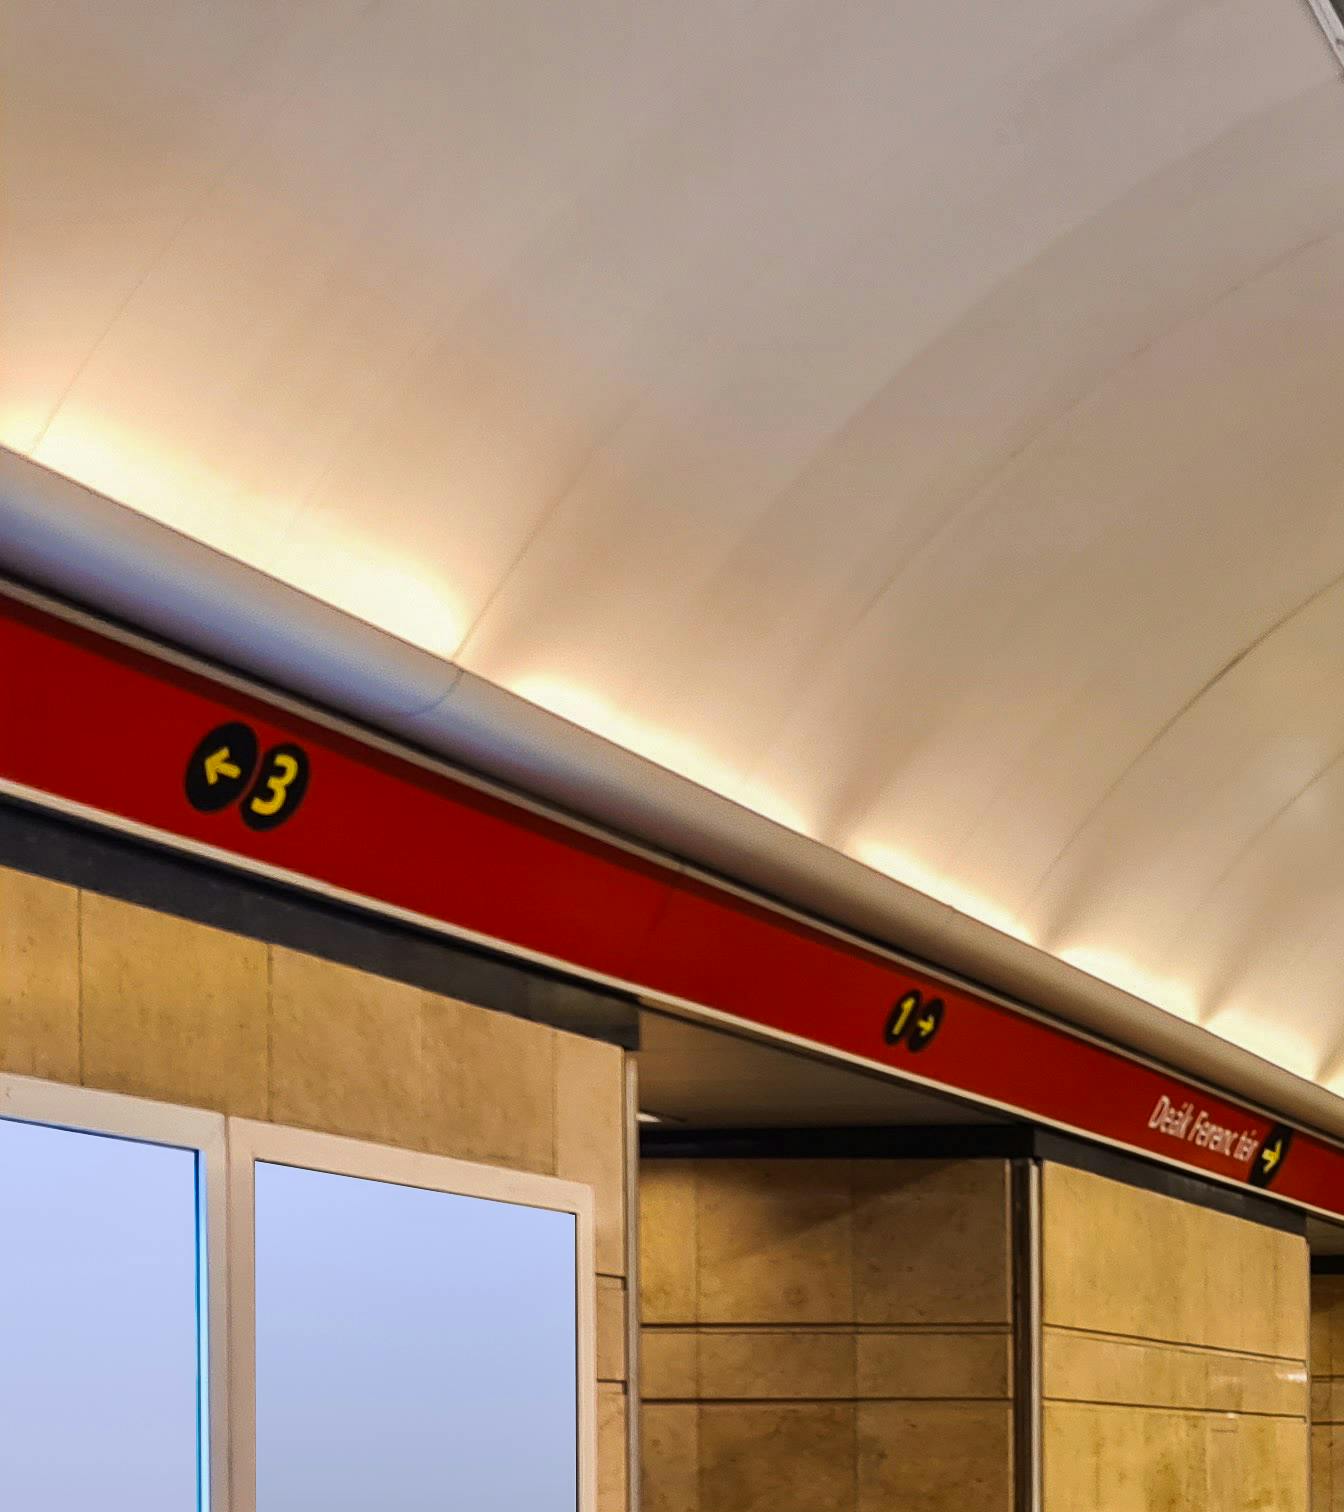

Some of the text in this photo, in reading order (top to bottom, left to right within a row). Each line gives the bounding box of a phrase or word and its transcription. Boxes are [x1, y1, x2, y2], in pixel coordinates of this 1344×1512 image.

[251, 753, 298, 816] 3
[892, 997, 915, 1035] 1
[1148, 1095, 1194, 1139] Deák
[1187, 1110, 1239, 1157] Ferenc
